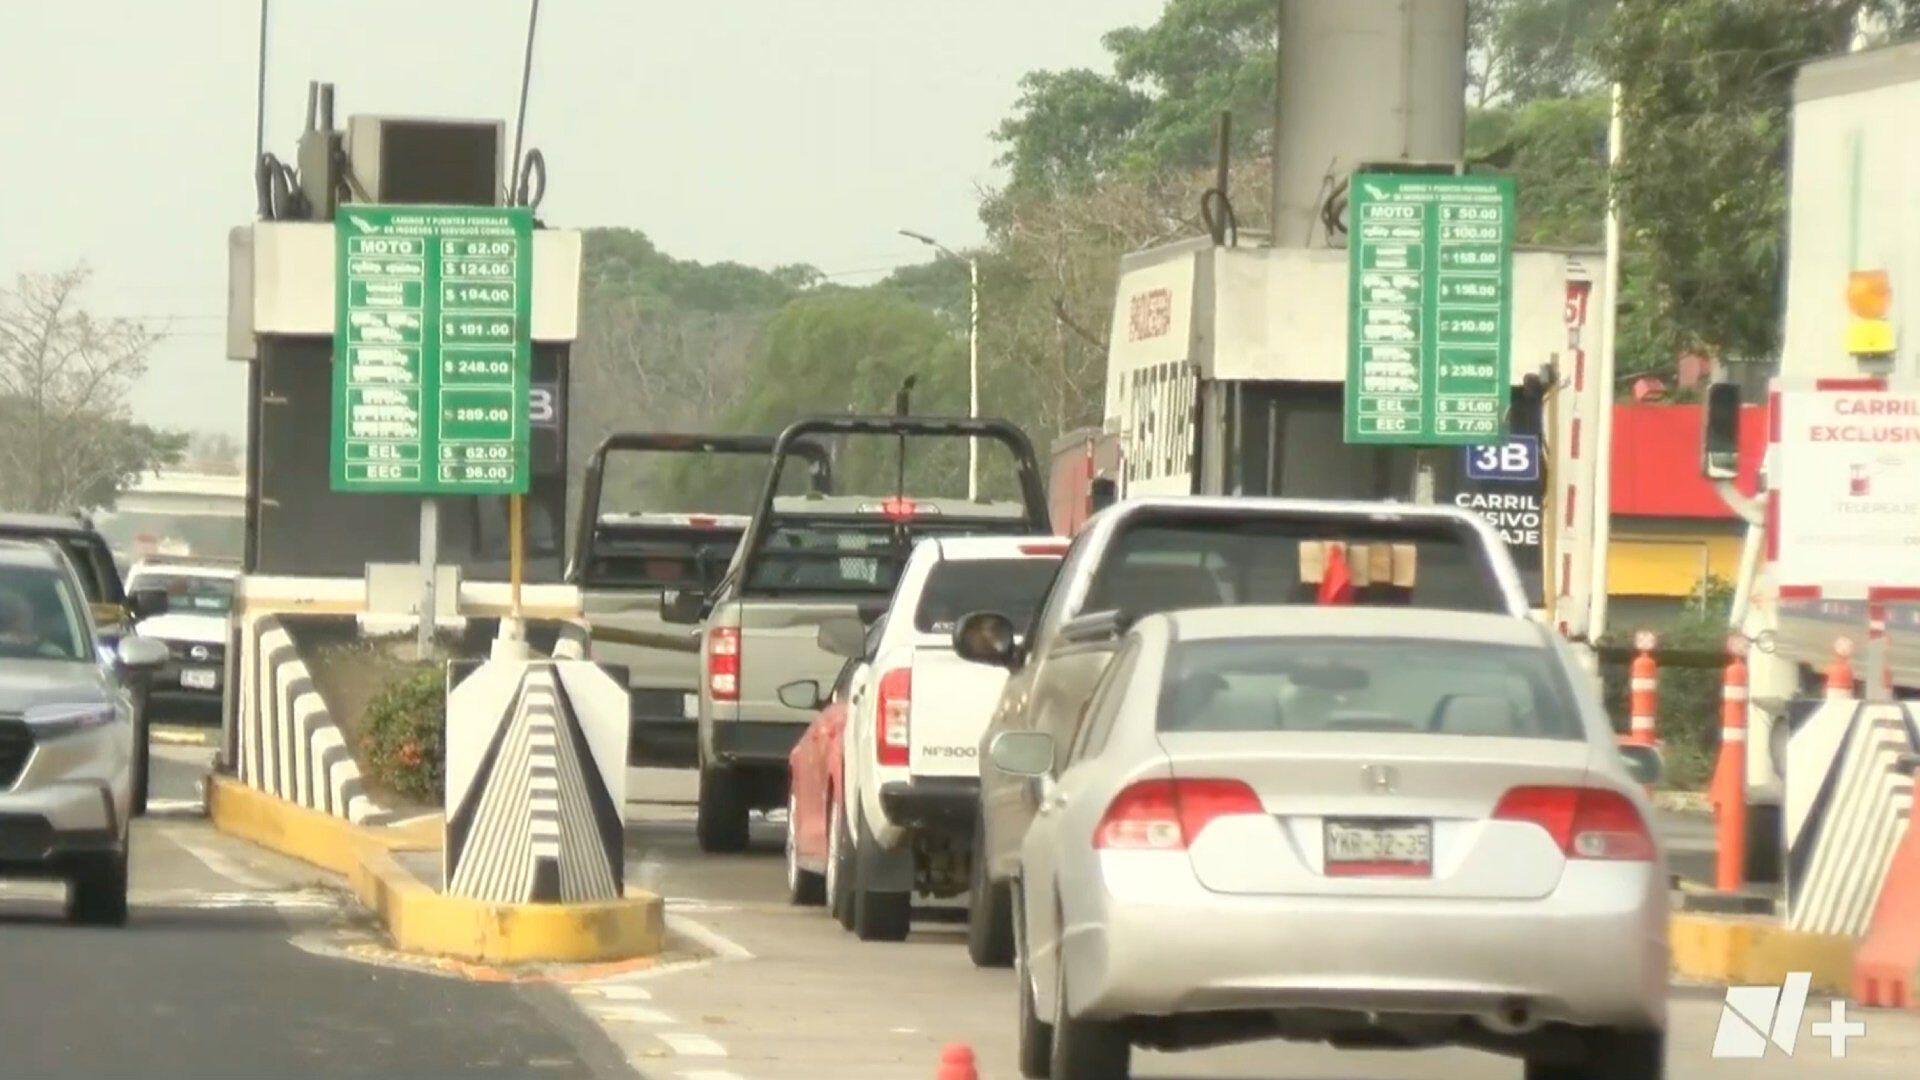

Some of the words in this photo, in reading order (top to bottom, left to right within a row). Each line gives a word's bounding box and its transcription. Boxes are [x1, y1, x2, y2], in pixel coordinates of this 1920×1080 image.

[1370, 206, 1414, 218] MOTO
[1459, 208, 1497, 219] 50.00
[360, 240, 412, 253] MOTO
[445, 243, 454, 254] $
[467, 243, 509, 254] 62.00
[446, 262, 455, 274] $
[460, 263, 509, 275] 124.00
[445, 289, 454, 301] $
[445, 323, 454, 335] $
[458, 361, 508, 373] 248.00
[1377, 401, 1405, 412] EEL
[1377, 419, 1406, 430] EEC
[1457, 420, 1493, 431] 77.00
[368, 445, 400, 458] EEL
[466, 447, 507, 458] 62.00
[1476, 443, 1529, 470] 3B
[367, 465, 401, 478] EEC
[1455, 493, 1539, 510] CARRIL
